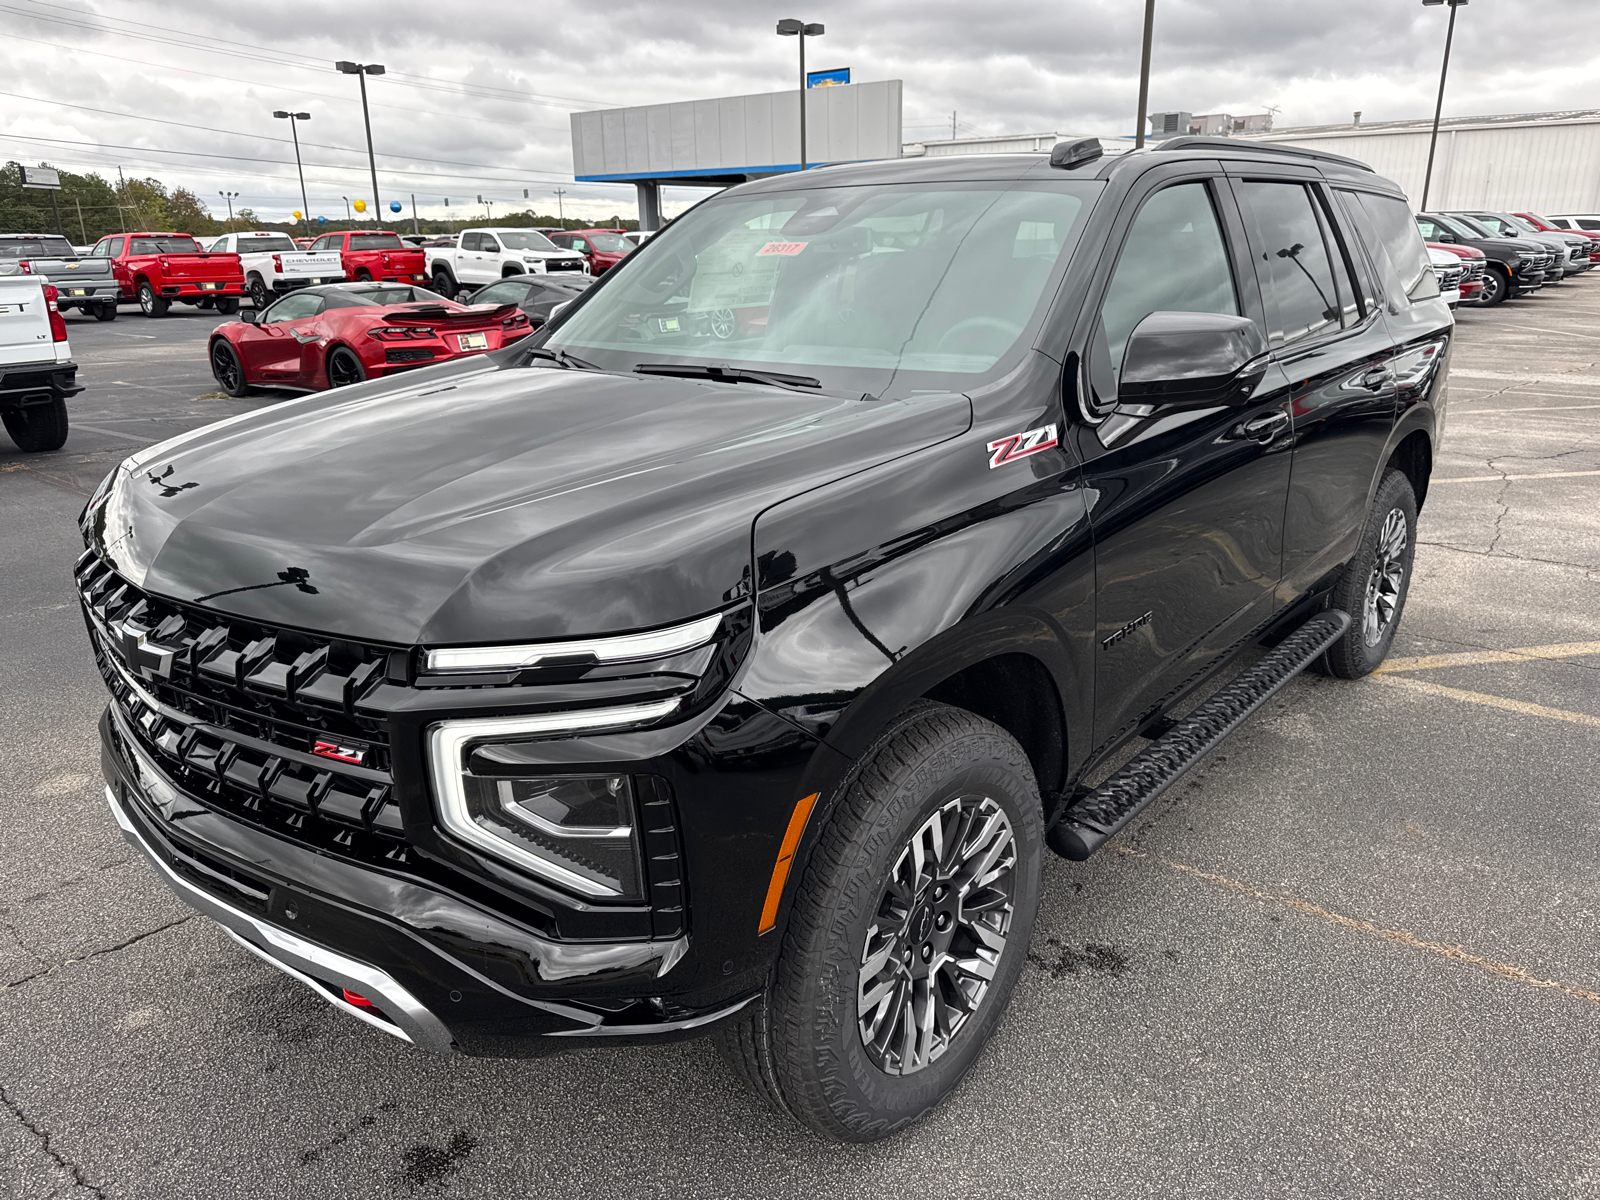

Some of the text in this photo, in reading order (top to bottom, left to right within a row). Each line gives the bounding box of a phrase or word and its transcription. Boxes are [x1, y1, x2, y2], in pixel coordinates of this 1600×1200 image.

[765, 243, 800, 253] 26317
[986, 423, 1059, 470] Z71
[313, 740, 363, 764] Z71
